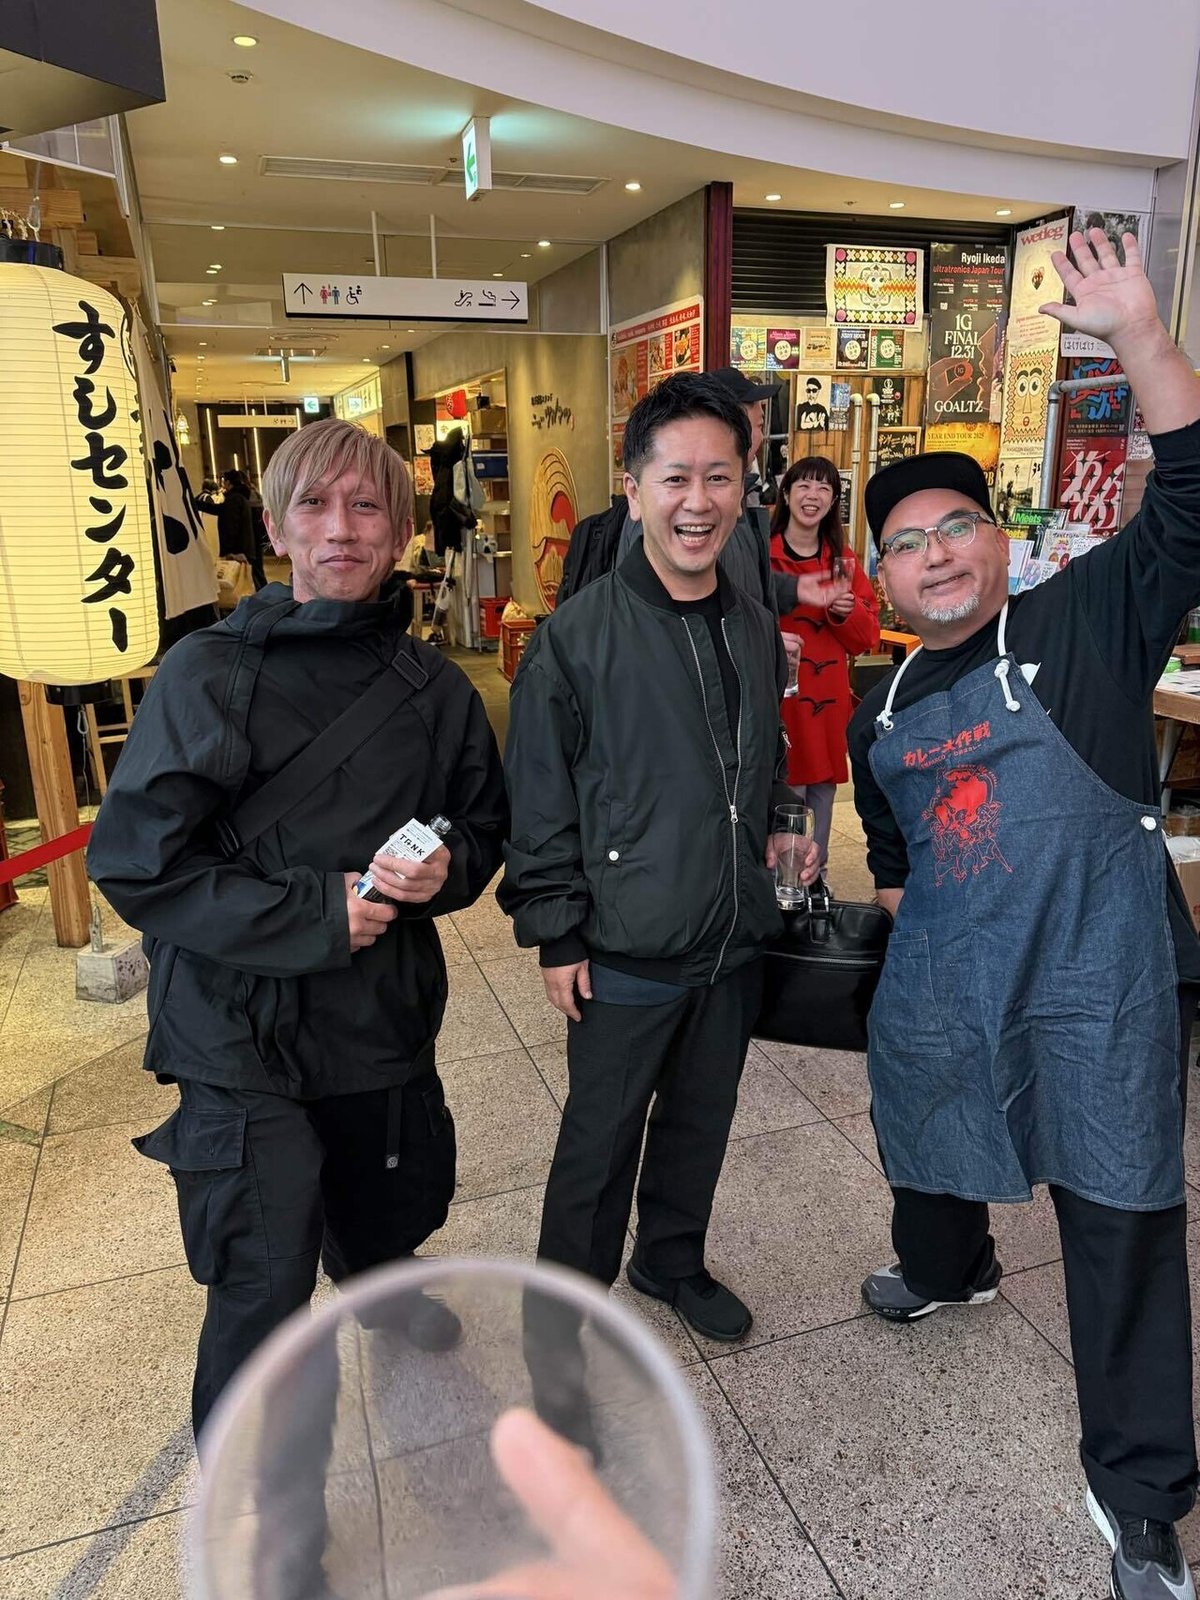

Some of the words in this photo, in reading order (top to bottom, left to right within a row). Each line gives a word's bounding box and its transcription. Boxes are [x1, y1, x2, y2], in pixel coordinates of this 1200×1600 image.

[961, 252, 981, 265] Ryoji
[983, 253, 1006, 264] Ikeda
[933, 264, 970, 273] ultratronics
[971, 265, 990, 275] Japan
[990, 266, 1005, 274] Tour
[955, 313, 973, 331] 1G
[944, 330, 982, 346] FINAL
[951, 345, 975, 358] 12.31
[934, 400, 984, 413] GOALTZ
[927, 432, 943, 440] YEAR
[944, 432, 956, 440] END
[956, 432, 972, 440] TOUR
[52, 300, 136, 653] すしセンター
